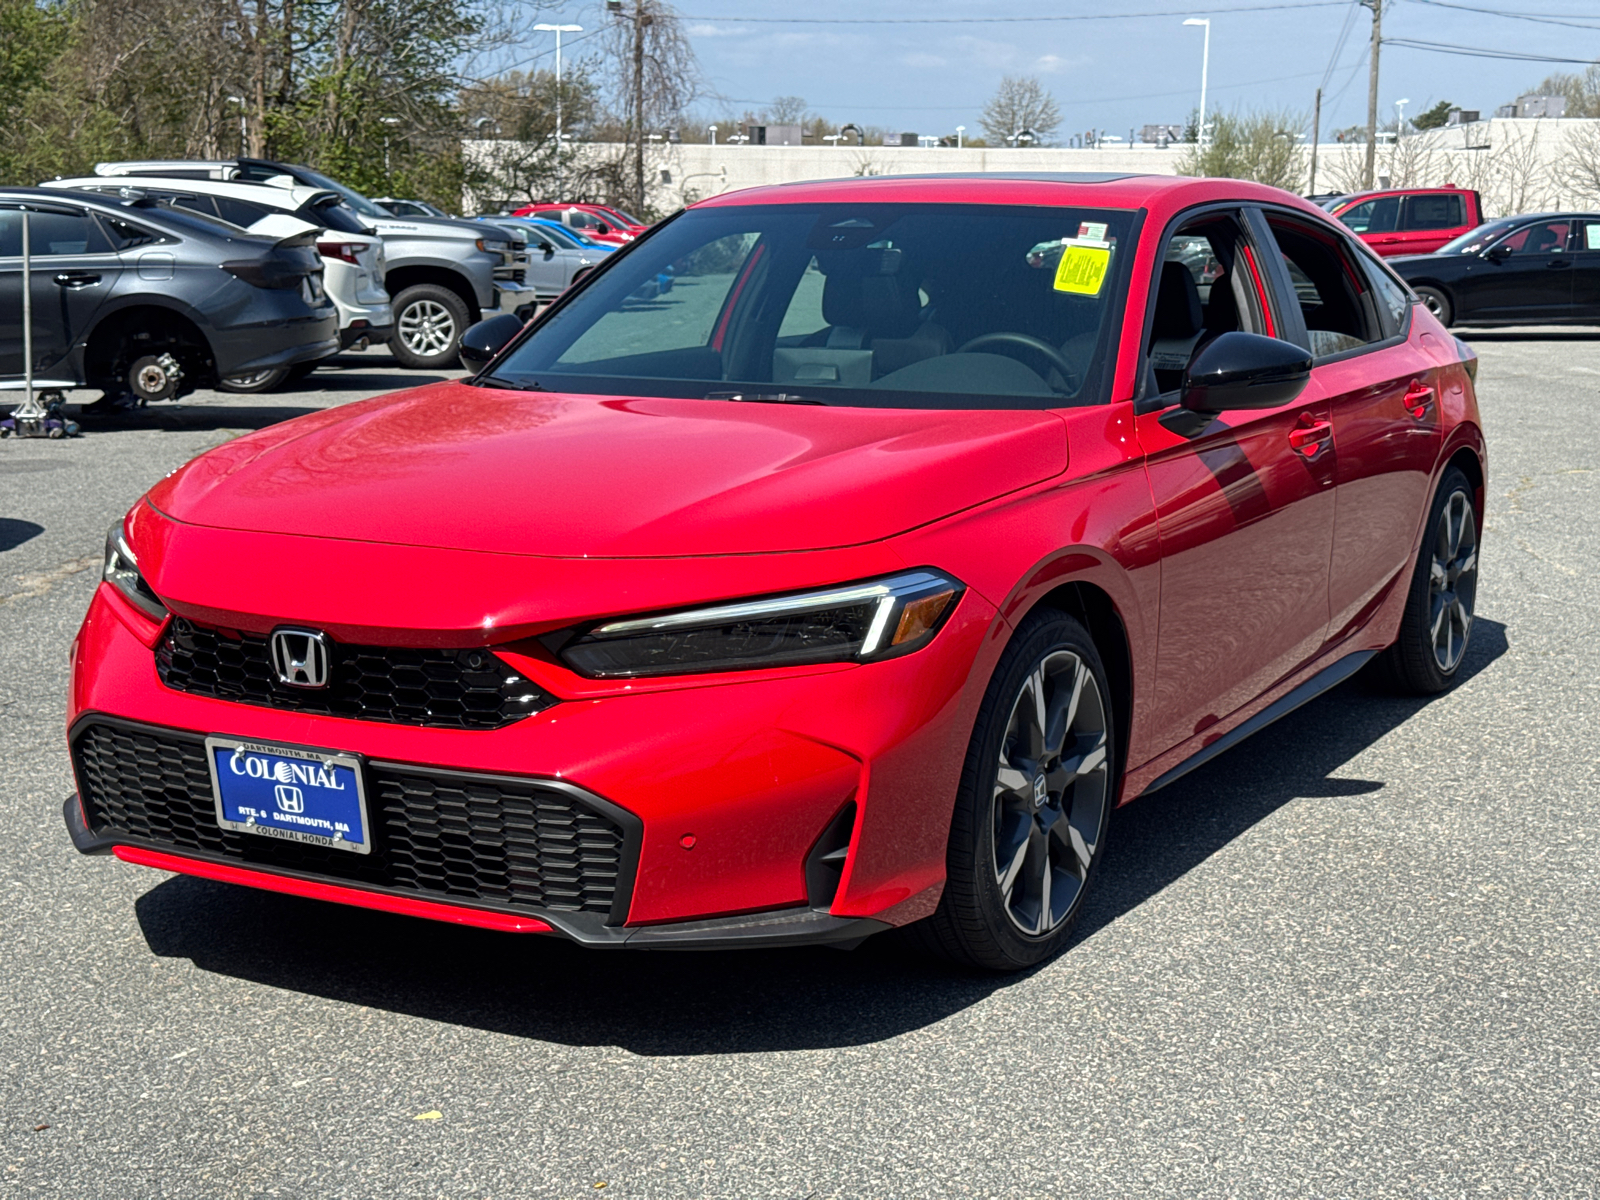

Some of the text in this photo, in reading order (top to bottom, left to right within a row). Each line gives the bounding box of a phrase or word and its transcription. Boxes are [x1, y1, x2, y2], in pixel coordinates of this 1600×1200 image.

[243, 742, 322, 761] DARTMOUTH, MA
[230, 752, 345, 791] COLONIAL
[238, 806, 350, 833] RTE. 6 DARTMOUTH, MA
[256, 826, 334, 847] COLONIAL HONDA
